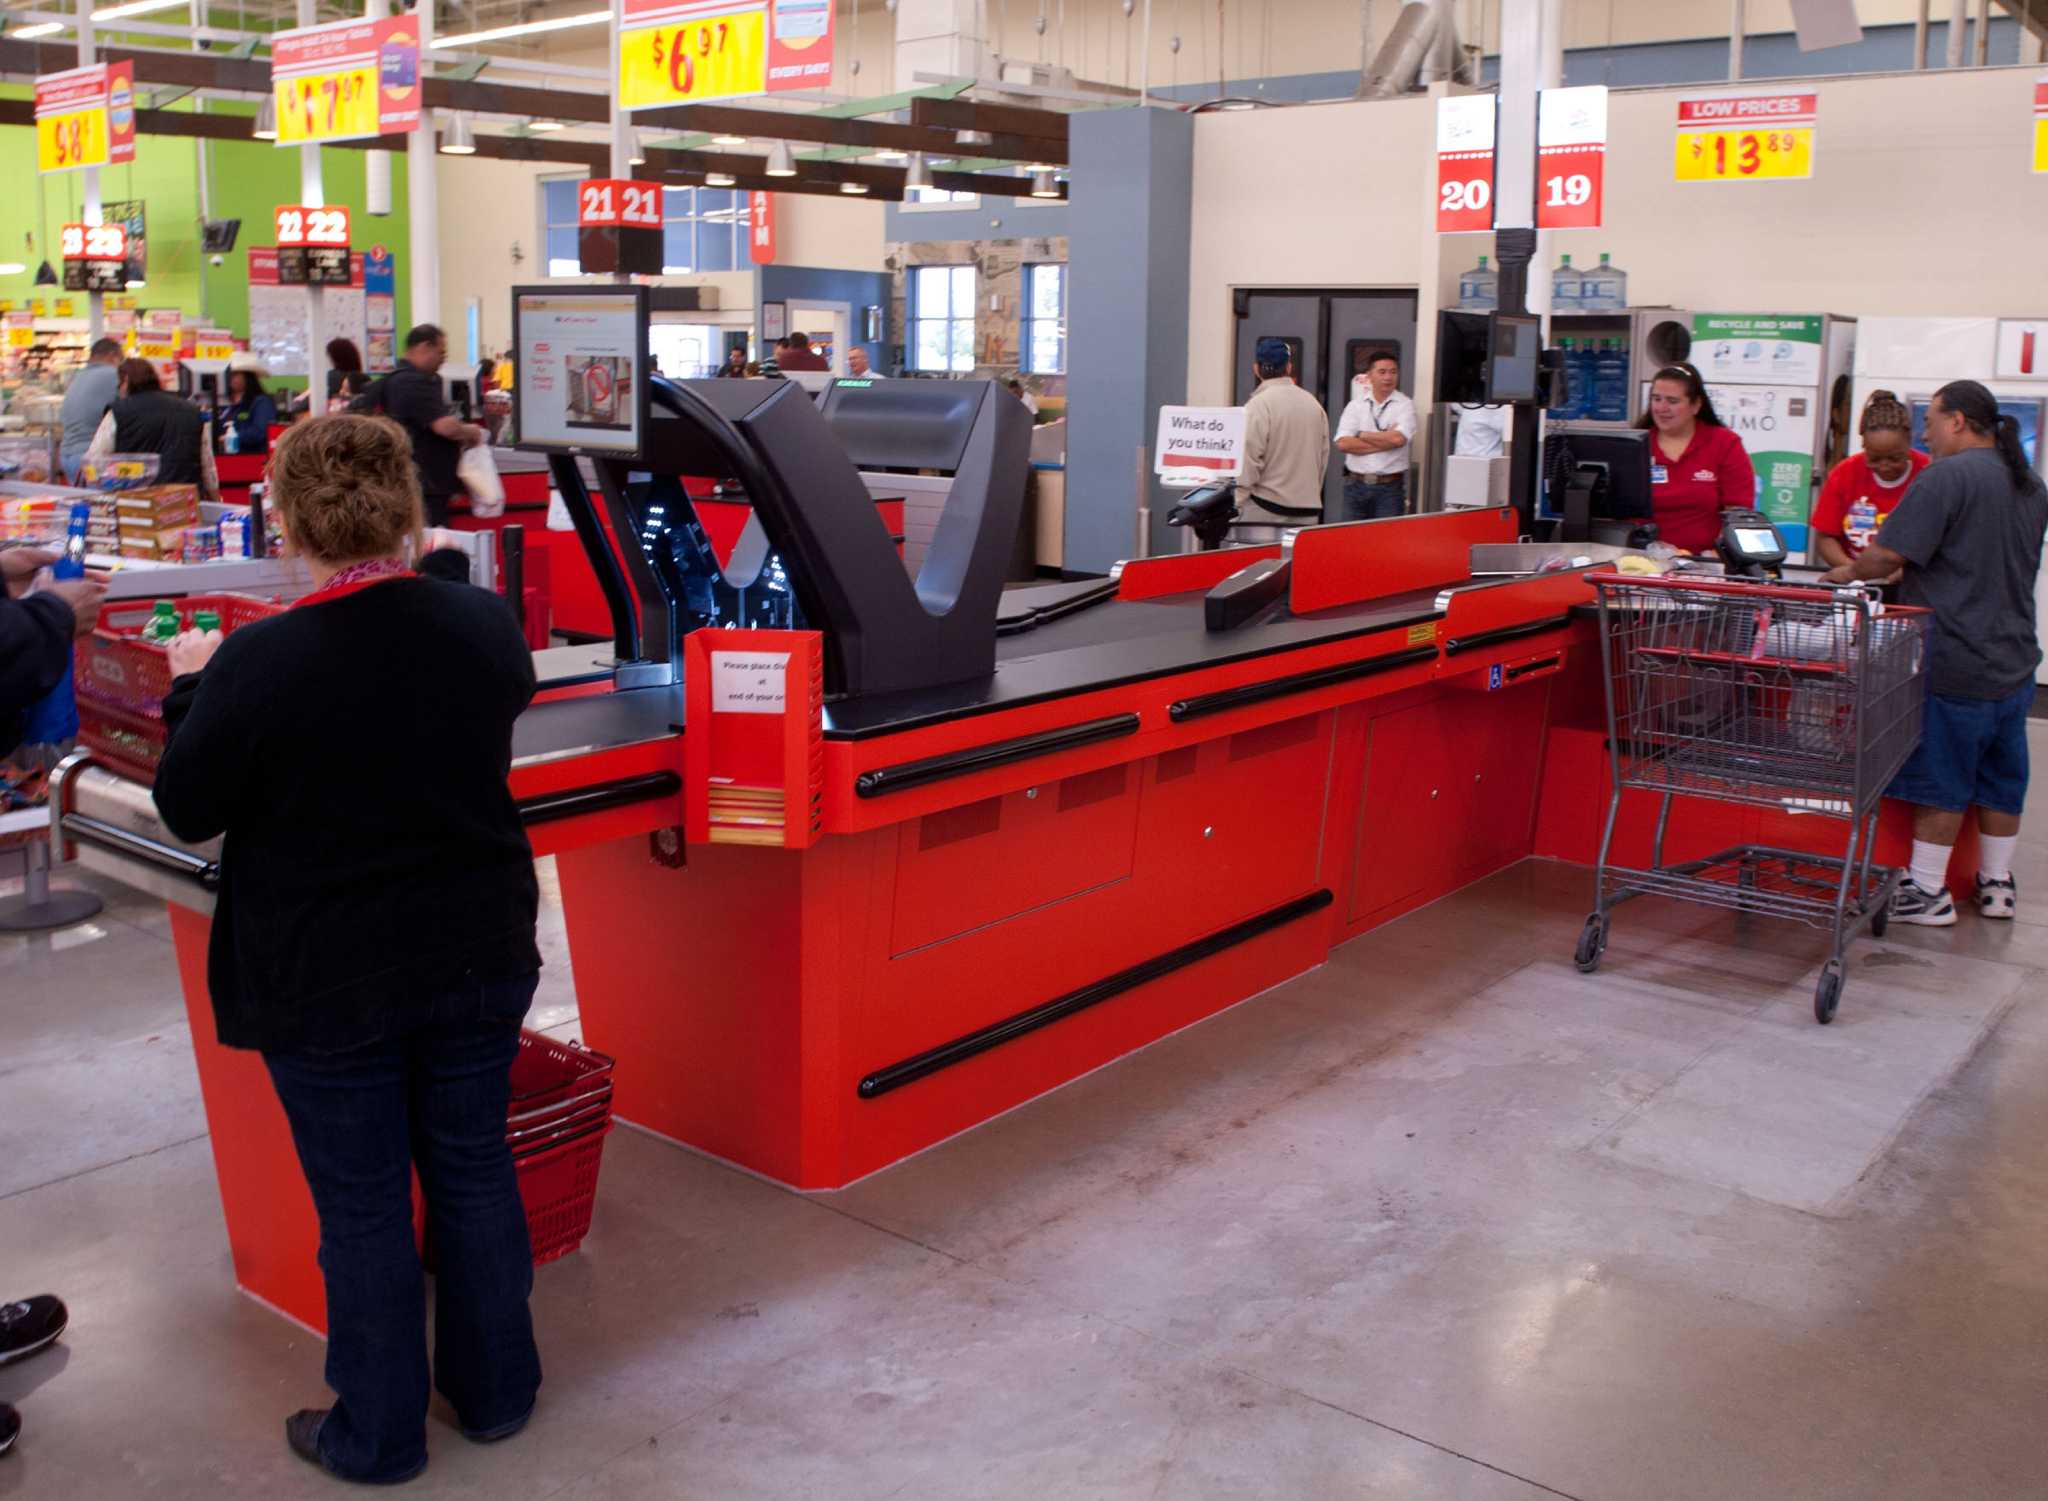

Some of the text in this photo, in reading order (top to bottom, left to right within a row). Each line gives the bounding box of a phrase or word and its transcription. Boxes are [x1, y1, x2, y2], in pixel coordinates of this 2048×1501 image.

[1692, 97, 1800, 117] LOW PRICES
[583, 186, 617, 222] 21
[622, 188, 660, 224] 21
[1440, 179, 1490, 211] 20
[1546, 174, 1592, 207] 19
[277, 210, 304, 242] 22
[306, 210, 348, 242] 22
[1171, 416, 1224, 432] What do
[1168, 437, 1235, 452] you think?
[723, 662, 749, 670] Please
[750, 662, 771, 671] place
[745, 692, 754, 701] of
[755, 694, 774, 703] your
